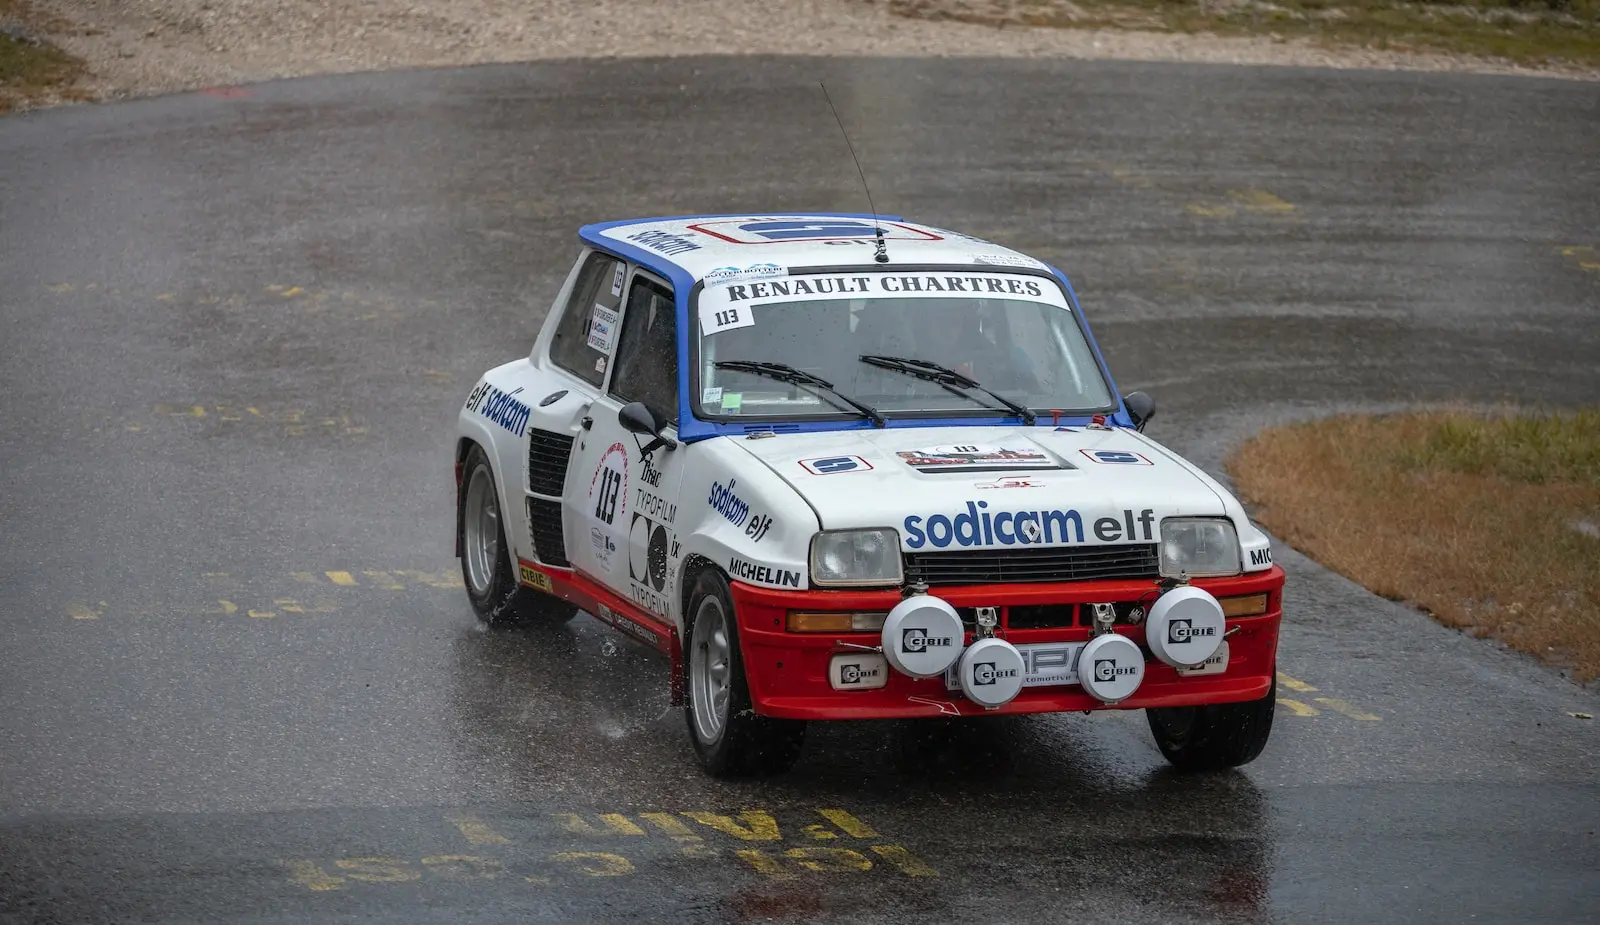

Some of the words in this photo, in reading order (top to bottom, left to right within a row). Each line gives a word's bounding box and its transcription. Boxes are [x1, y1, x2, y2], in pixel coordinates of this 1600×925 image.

[726, 276, 870, 302] RENAULT
[880, 276, 1042, 297] CHARTRES
[715, 309, 739, 326] 113
[466, 382, 492, 412] elf
[481, 387, 530, 437] sodicam
[595, 466, 622, 525] 113
[635, 488, 677, 524] TYPOFILM
[708, 478, 749, 527] sodicam
[745, 514, 773, 542] elf
[904, 500, 1084, 549] sodicam
[1093, 508, 1154, 542] elf
[729, 557, 801, 588] MICHELIN
[631, 583, 672, 620] TYPOFILM
